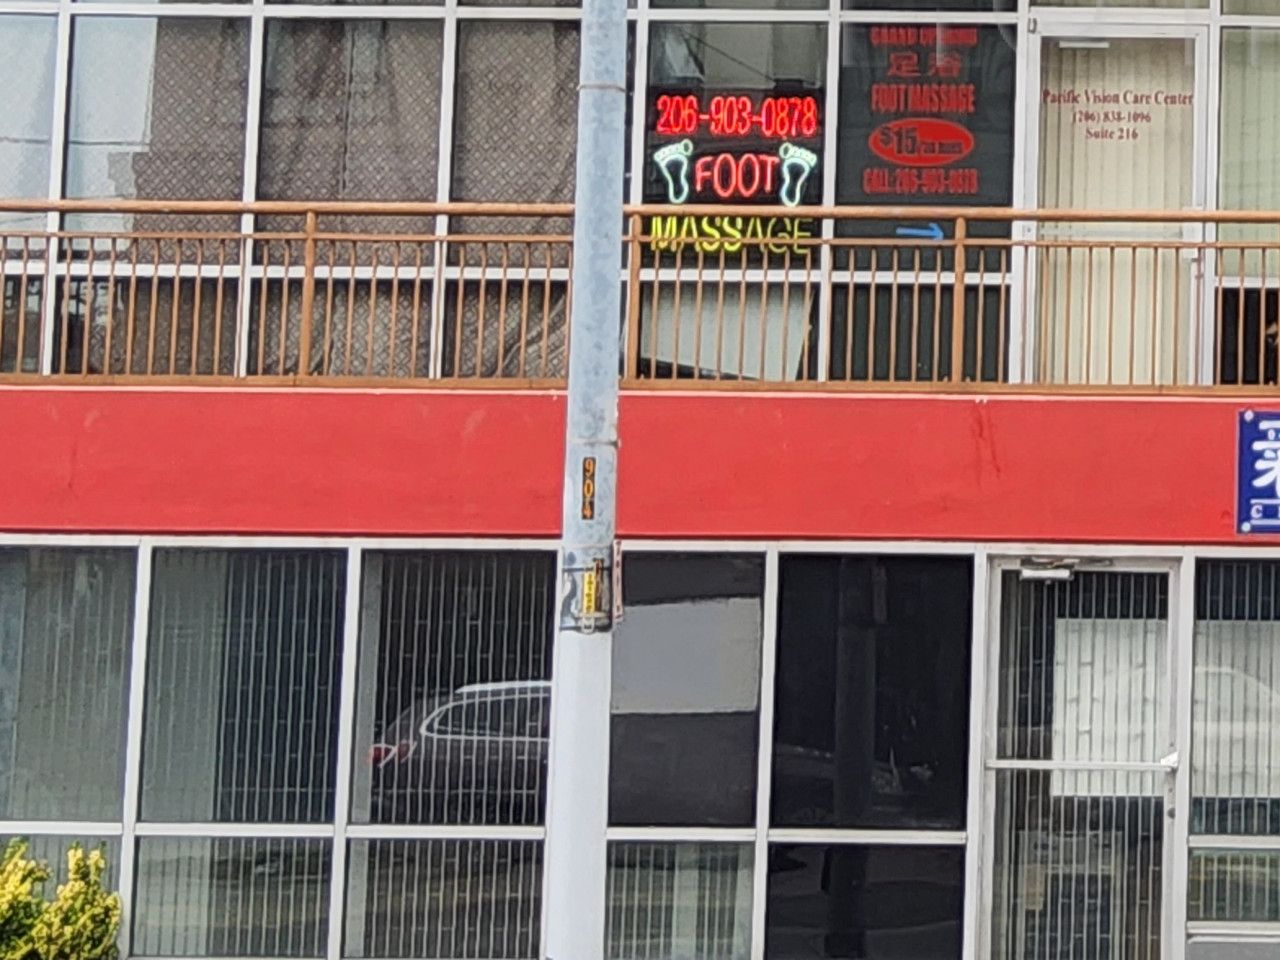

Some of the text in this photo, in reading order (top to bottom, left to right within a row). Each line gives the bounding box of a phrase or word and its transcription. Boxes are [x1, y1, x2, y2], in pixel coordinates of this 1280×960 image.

[907, 83, 975, 114] MASSAGE
[1042, 89, 1194, 105] Pacific Vision Care Center
[656, 95, 818, 138] 206-903-0878
[1085, 127, 1138, 139] Suite 216
[695, 152, 780, 198] FOOT
[651, 214, 813, 254] MASSAGE
